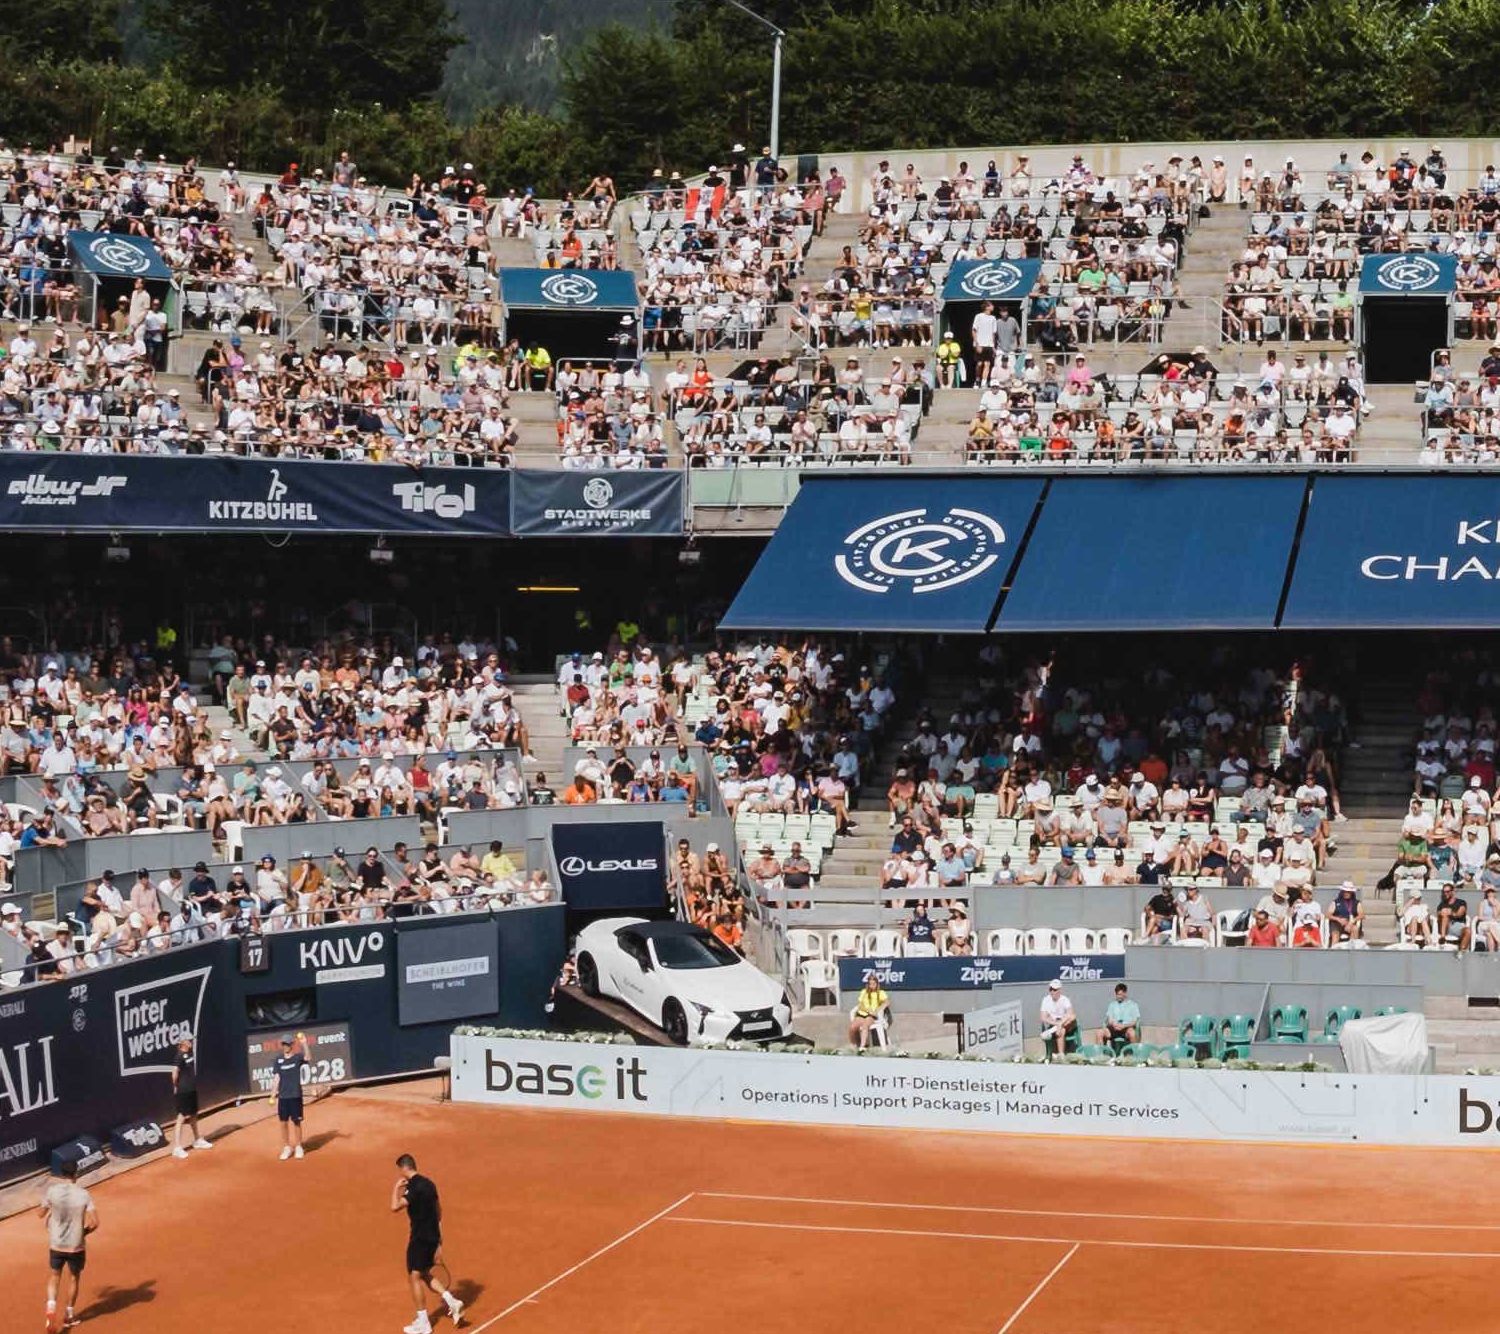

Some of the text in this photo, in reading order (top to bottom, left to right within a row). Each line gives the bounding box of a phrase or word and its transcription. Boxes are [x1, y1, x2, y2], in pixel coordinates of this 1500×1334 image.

[209, 500, 317, 520] KITZBÜHEL
[392, 481, 476, 518] Tirol
[544, 509, 651, 520] STADTWERKE
[586, 859, 658, 872] LEXUS
[247, 948, 263, 967] 17
[960, 966, 1005, 985] Zipfer
[1059, 965, 1104, 980] Zipfer
[123, 998, 168, 1032] inter
[1008, 1015, 1020, 1036] it
[248, 1043, 263, 1054] an
[317, 1031, 347, 1045] event
[484, 1048, 648, 1101] base it
[865, 1074, 1046, 1095] Ihr IT-Dienstleister für
[741, 1087, 1180, 1120] Operations Support Packages Managed IT Services
